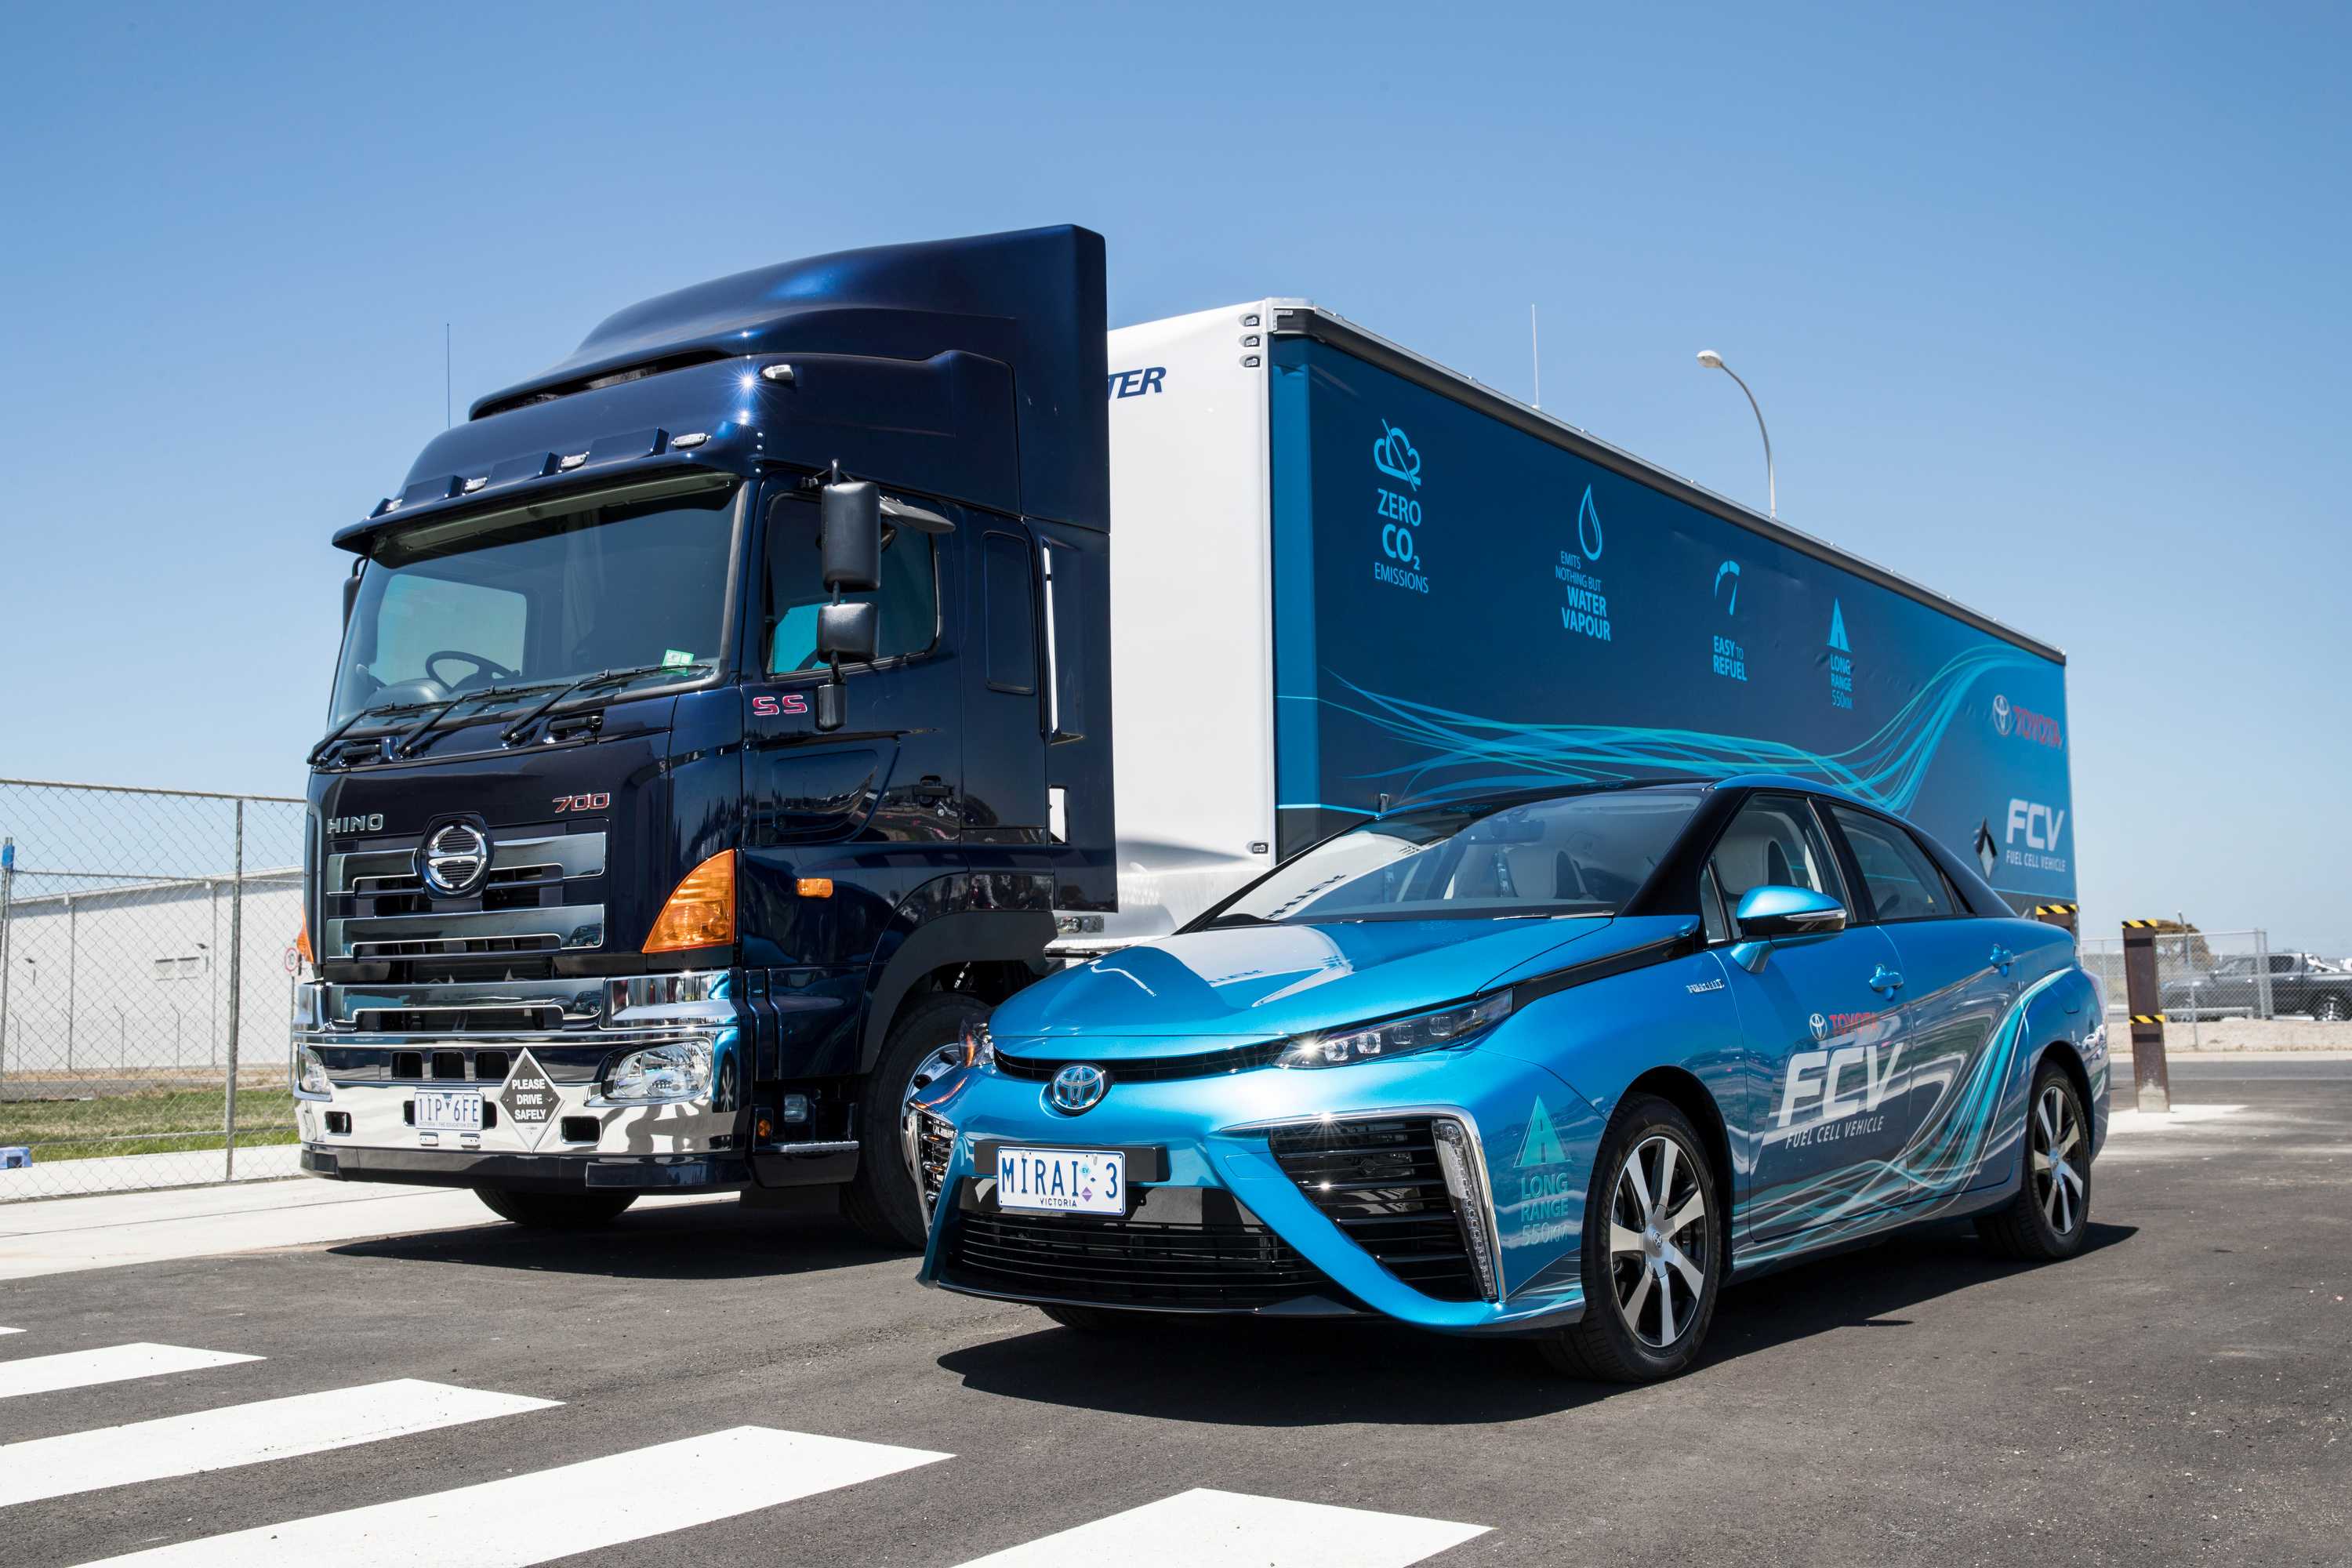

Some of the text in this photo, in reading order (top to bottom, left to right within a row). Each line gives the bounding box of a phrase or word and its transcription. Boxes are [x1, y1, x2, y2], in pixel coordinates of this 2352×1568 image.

[1377, 488, 1421, 526] ZERO
[1561, 550, 1581, 569] EMITS
[1374, 562, 1428, 593] EMISSIONS
[1555, 564, 1602, 592] NOTHING BUT
[1567, 585, 1607, 617] WATER
[1562, 607, 1611, 641] VAPOUR
[1714, 636, 1744, 659] EASY TO
[1713, 655, 1748, 681] REFUEL
[1831, 653, 1851, 675] LONG
[1831, 673, 1852, 691] RANGE
[753, 695, 808, 716] SS
[2013, 705, 2063, 750] TOYOTA
[552, 793, 610, 813] 700
[327, 814, 383, 833] HINO
[2006, 798, 2065, 851] FCV
[2006, 850, 2066, 872] FUEL CELL VEHICLE
[1828, 1012, 1878, 1035] TOYOTA
[512, 1079, 546, 1090] PLEASE
[1777, 1043, 1904, 1127] FCV
[516, 1094, 543, 1105] DRIVE
[514, 1109, 546, 1120] SAFELY
[1785, 1116, 1885, 1149] FUEL CELL VEHICLE
[1002, 1158, 1117, 1199] MIRAI 3
[1521, 1173, 1568, 1199] LONG
[1040, 1198, 1077, 1207] VICTORIA
[1521, 1198, 1568, 1221] RANGE
